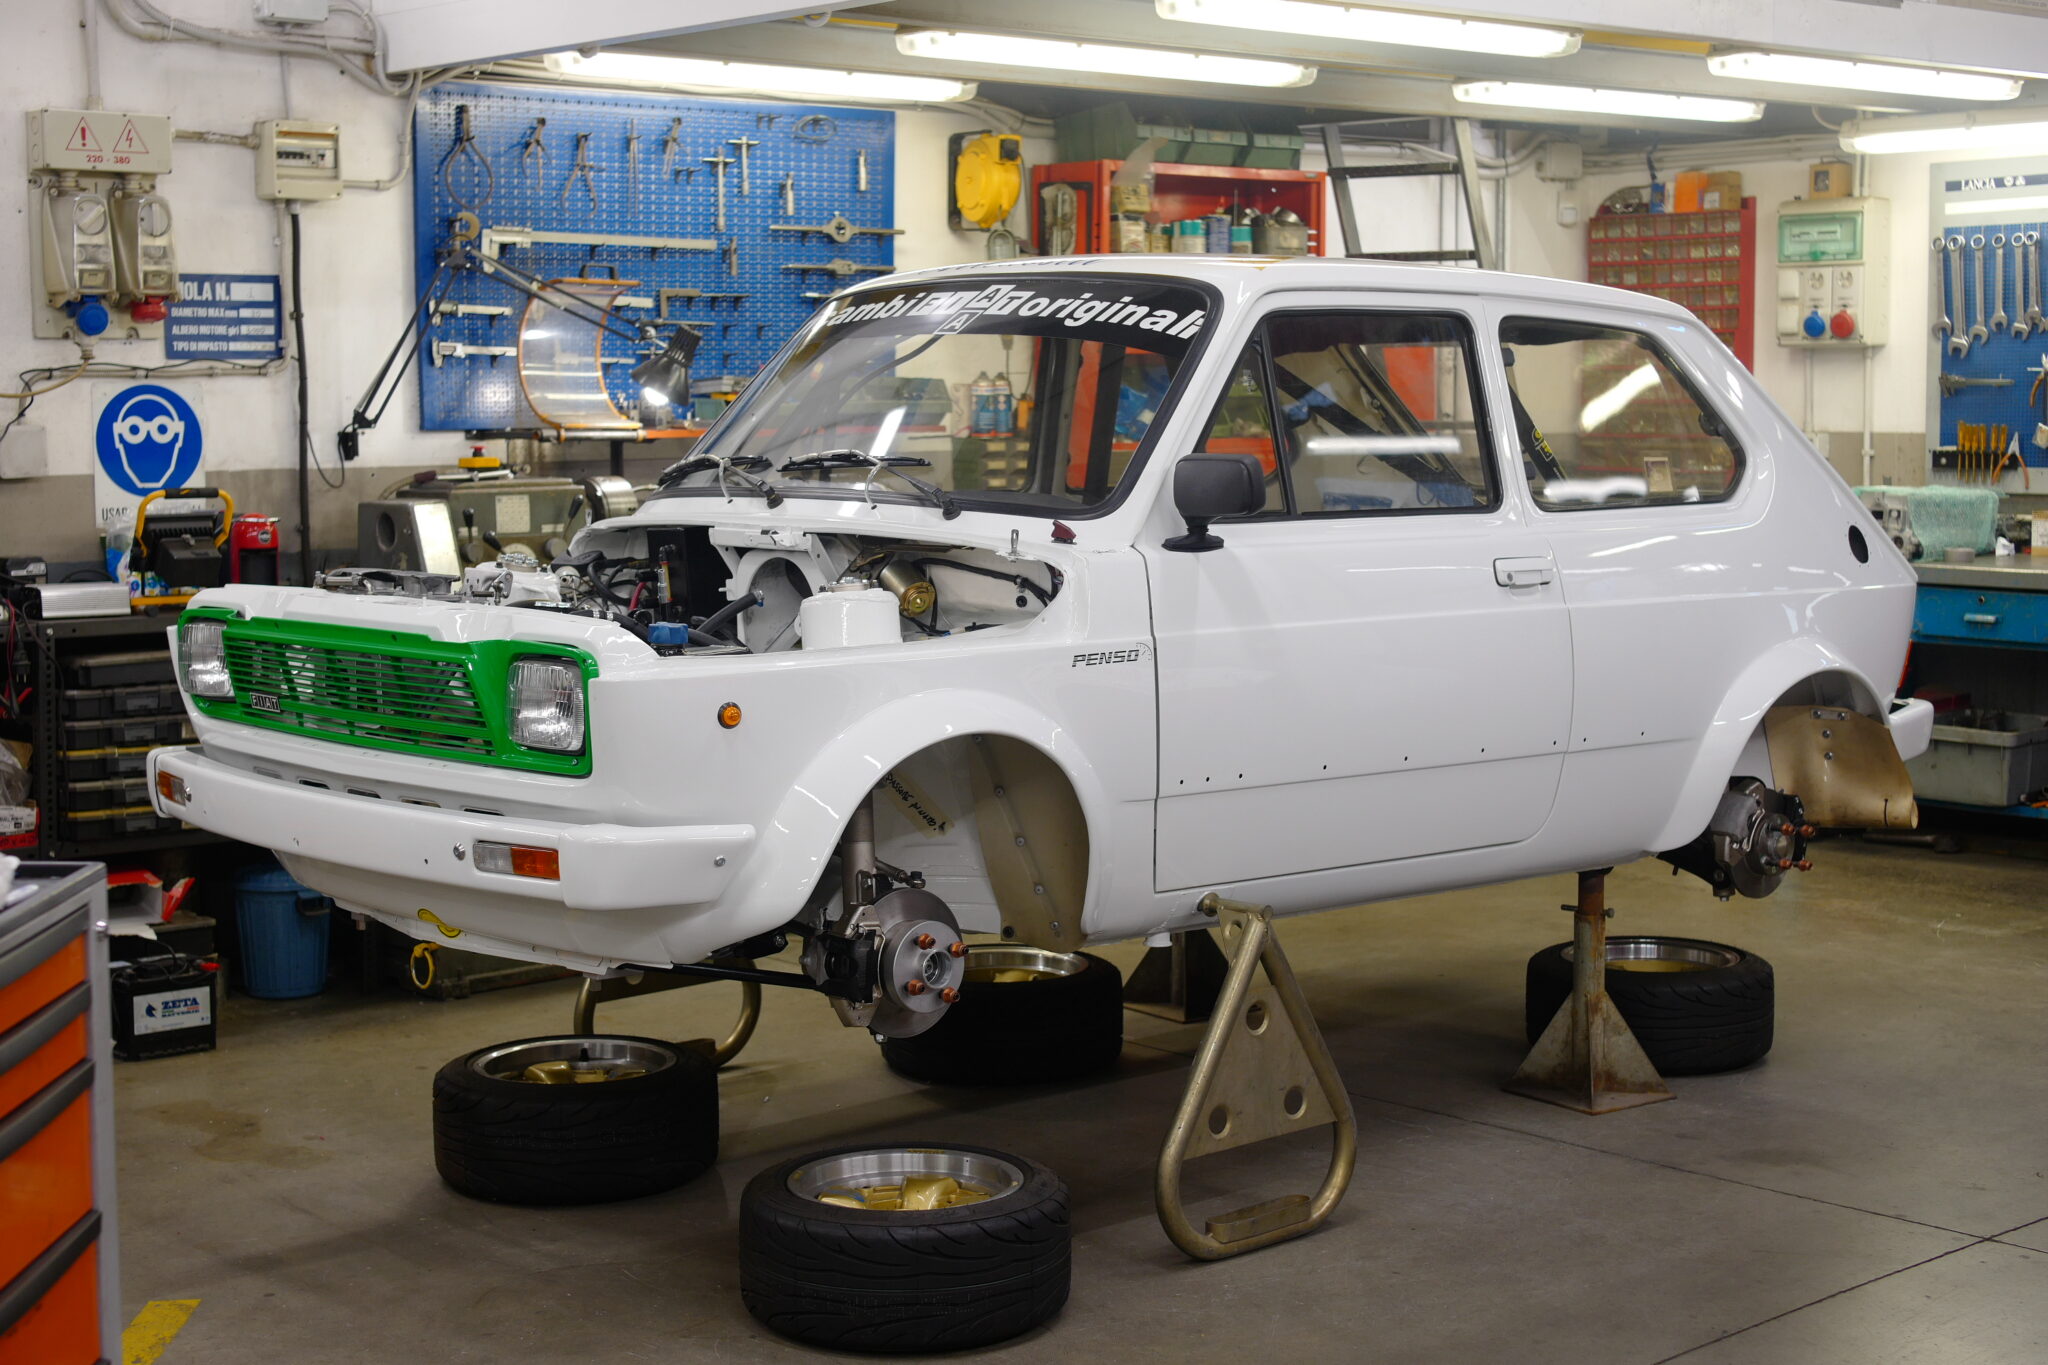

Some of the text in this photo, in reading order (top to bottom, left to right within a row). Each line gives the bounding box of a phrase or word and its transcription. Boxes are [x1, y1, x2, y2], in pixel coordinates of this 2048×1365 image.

[86, 155, 103, 163] 220
[113, 156, 130, 164] 380
[1961, 177, 1996, 190] LANCIA
[1018, 293, 1205, 340] originali
[1072, 649, 1139, 667] PENSO
[251, 693, 280, 711] FIAT
[161, 997, 200, 1010] ZETA
